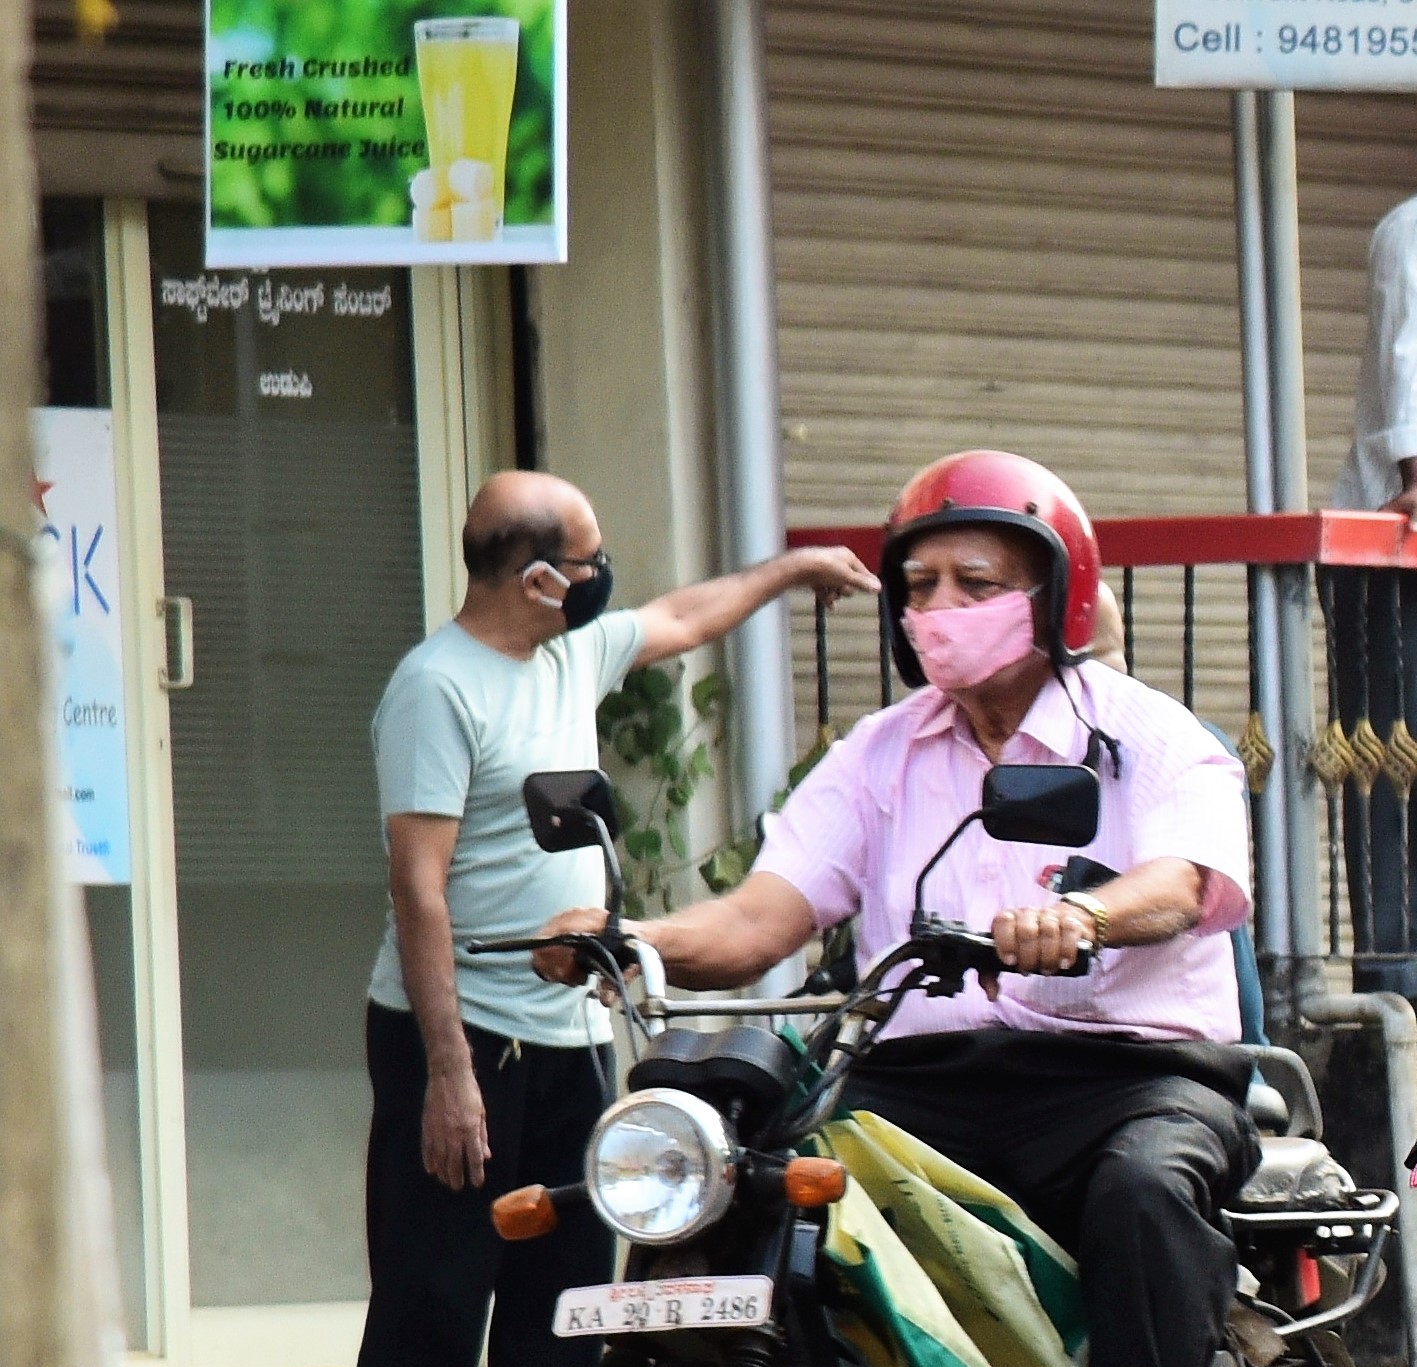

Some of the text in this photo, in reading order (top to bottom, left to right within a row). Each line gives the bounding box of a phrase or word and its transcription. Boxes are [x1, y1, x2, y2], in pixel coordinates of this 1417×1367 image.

[1173, 22, 1241, 52] Cell
[223, 55, 411, 79] Fresh Crushed
[225, 97, 405, 120] 100% Natural
[214, 134, 426, 164] Sugarcane Juice
[63, 695, 118, 728] Centre
[568, 1307, 604, 1331] KA
[701, 1295, 757, 1321] 2486
